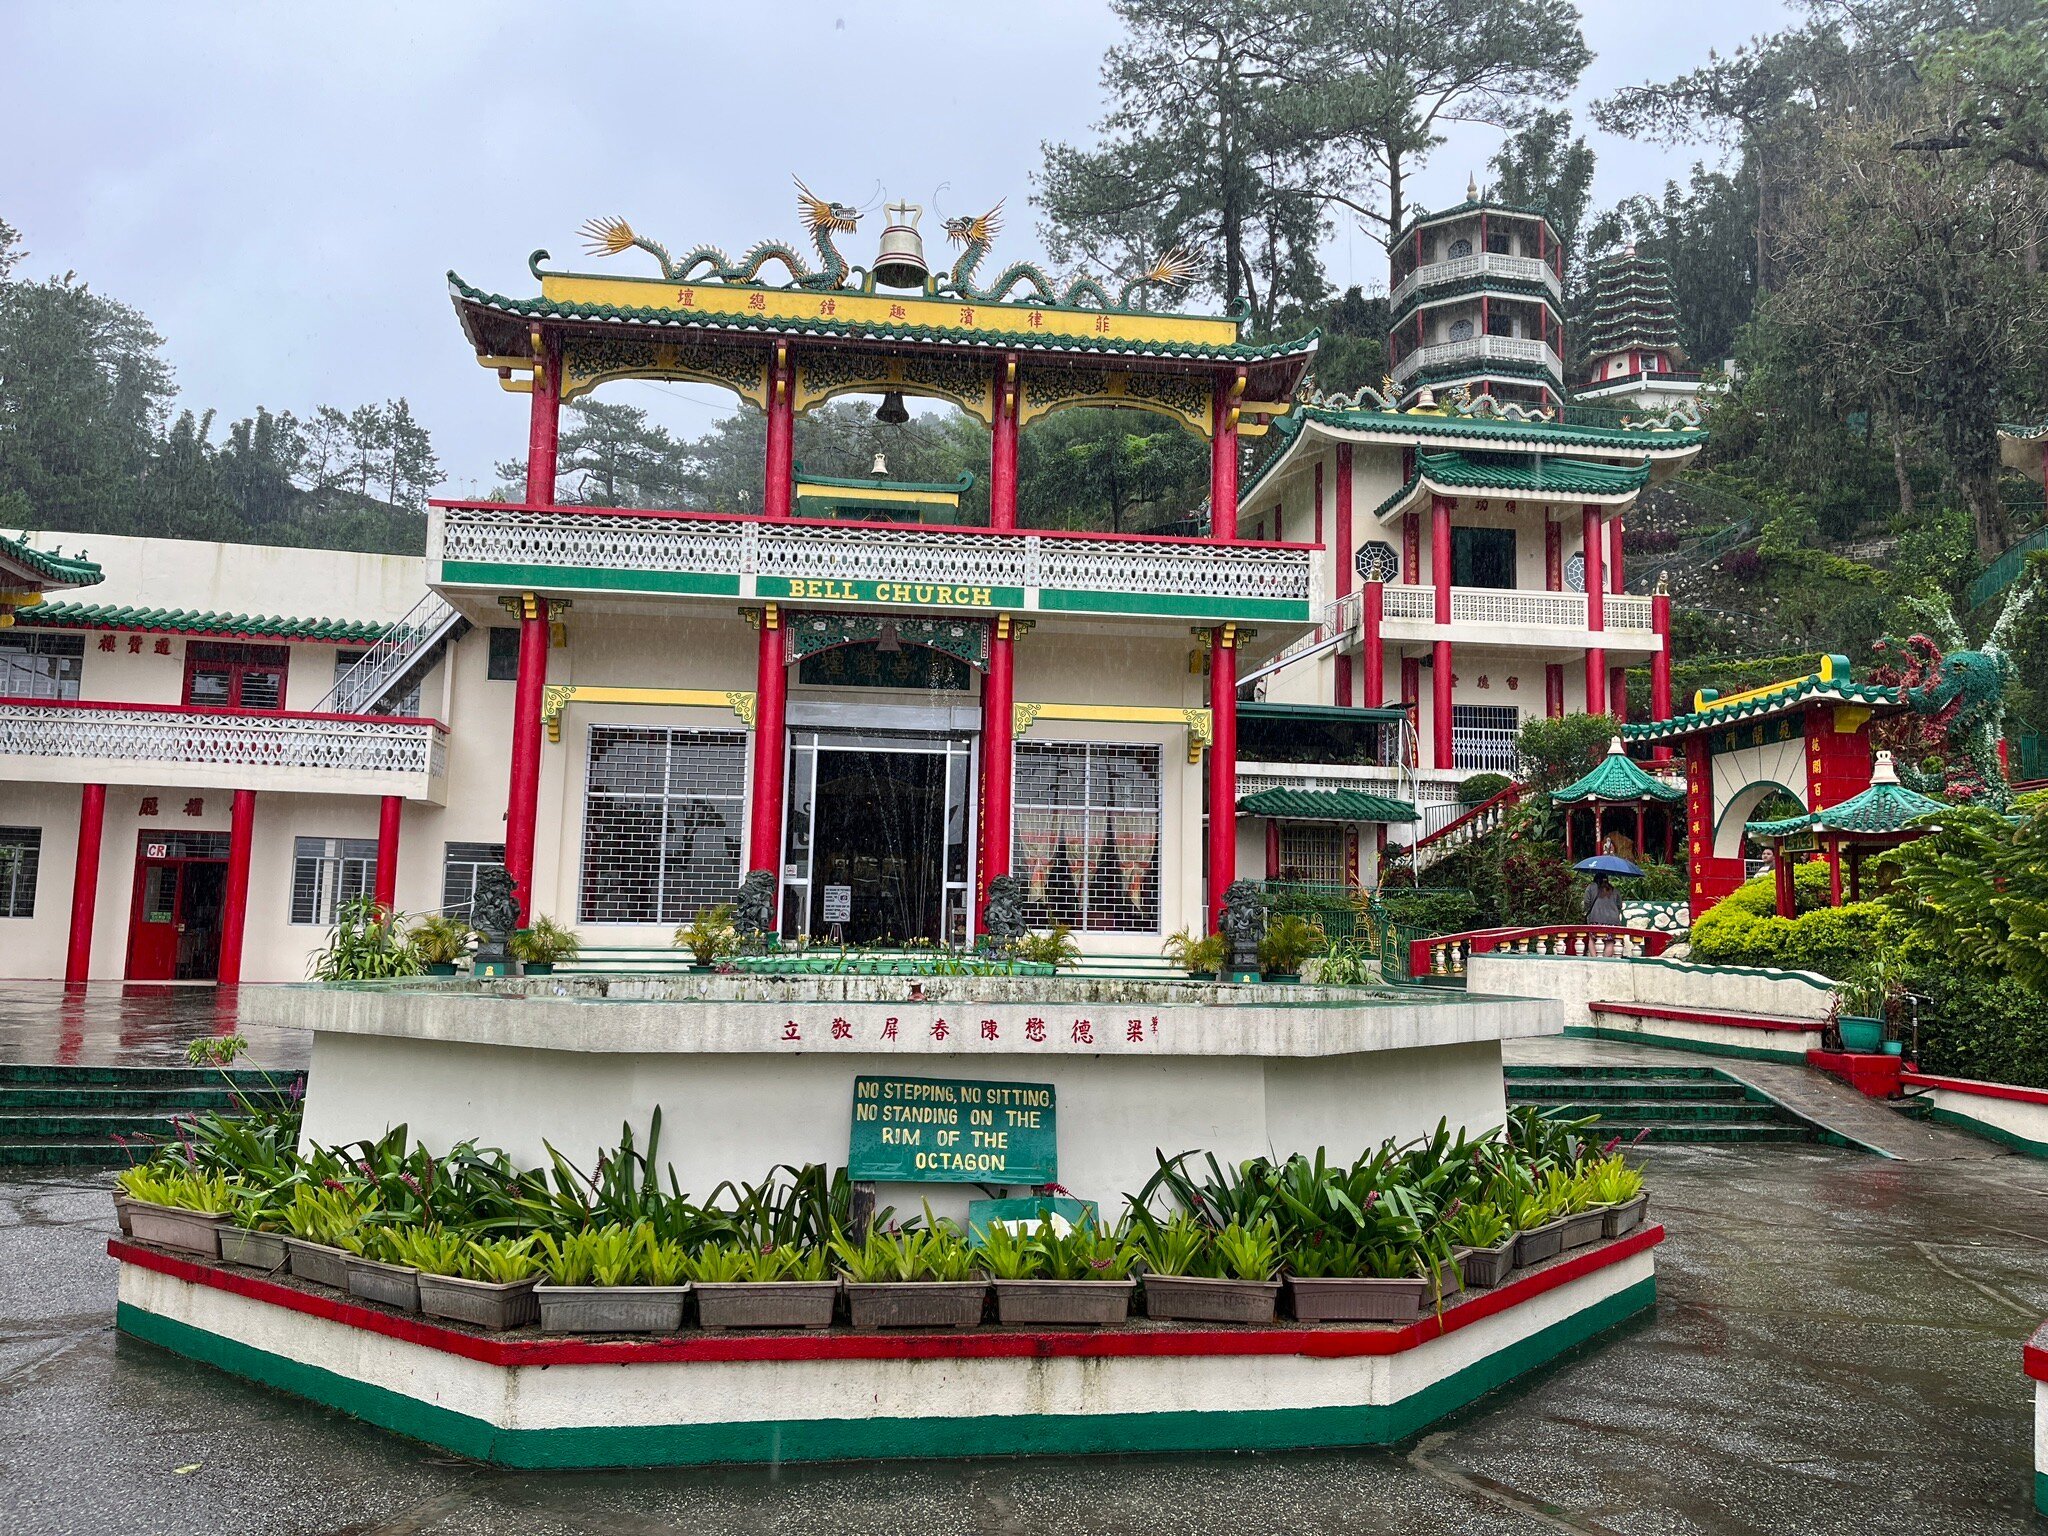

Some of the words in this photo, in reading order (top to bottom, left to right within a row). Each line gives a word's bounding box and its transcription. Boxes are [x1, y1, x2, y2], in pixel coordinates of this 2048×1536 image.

[789, 579, 859, 600] BELL
[876, 583, 993, 606] CHURCH
[148, 845, 165, 857] CR
[858, 1082, 879, 1099] NO
[884, 1083, 957, 1104] STEPPING,
[961, 1086, 981, 1104] NO
[856, 1104, 878, 1121] NO
[883, 1105, 958, 1125] STANDING
[970, 1109, 993, 1126] ON
[1005, 1110, 1041, 1128] THE
[882, 1127, 920, 1146] RIM
[937, 1130, 960, 1147] OF
[970, 1131, 1008, 1149] THE
[915, 1152, 1005, 1171] OCTAGON
